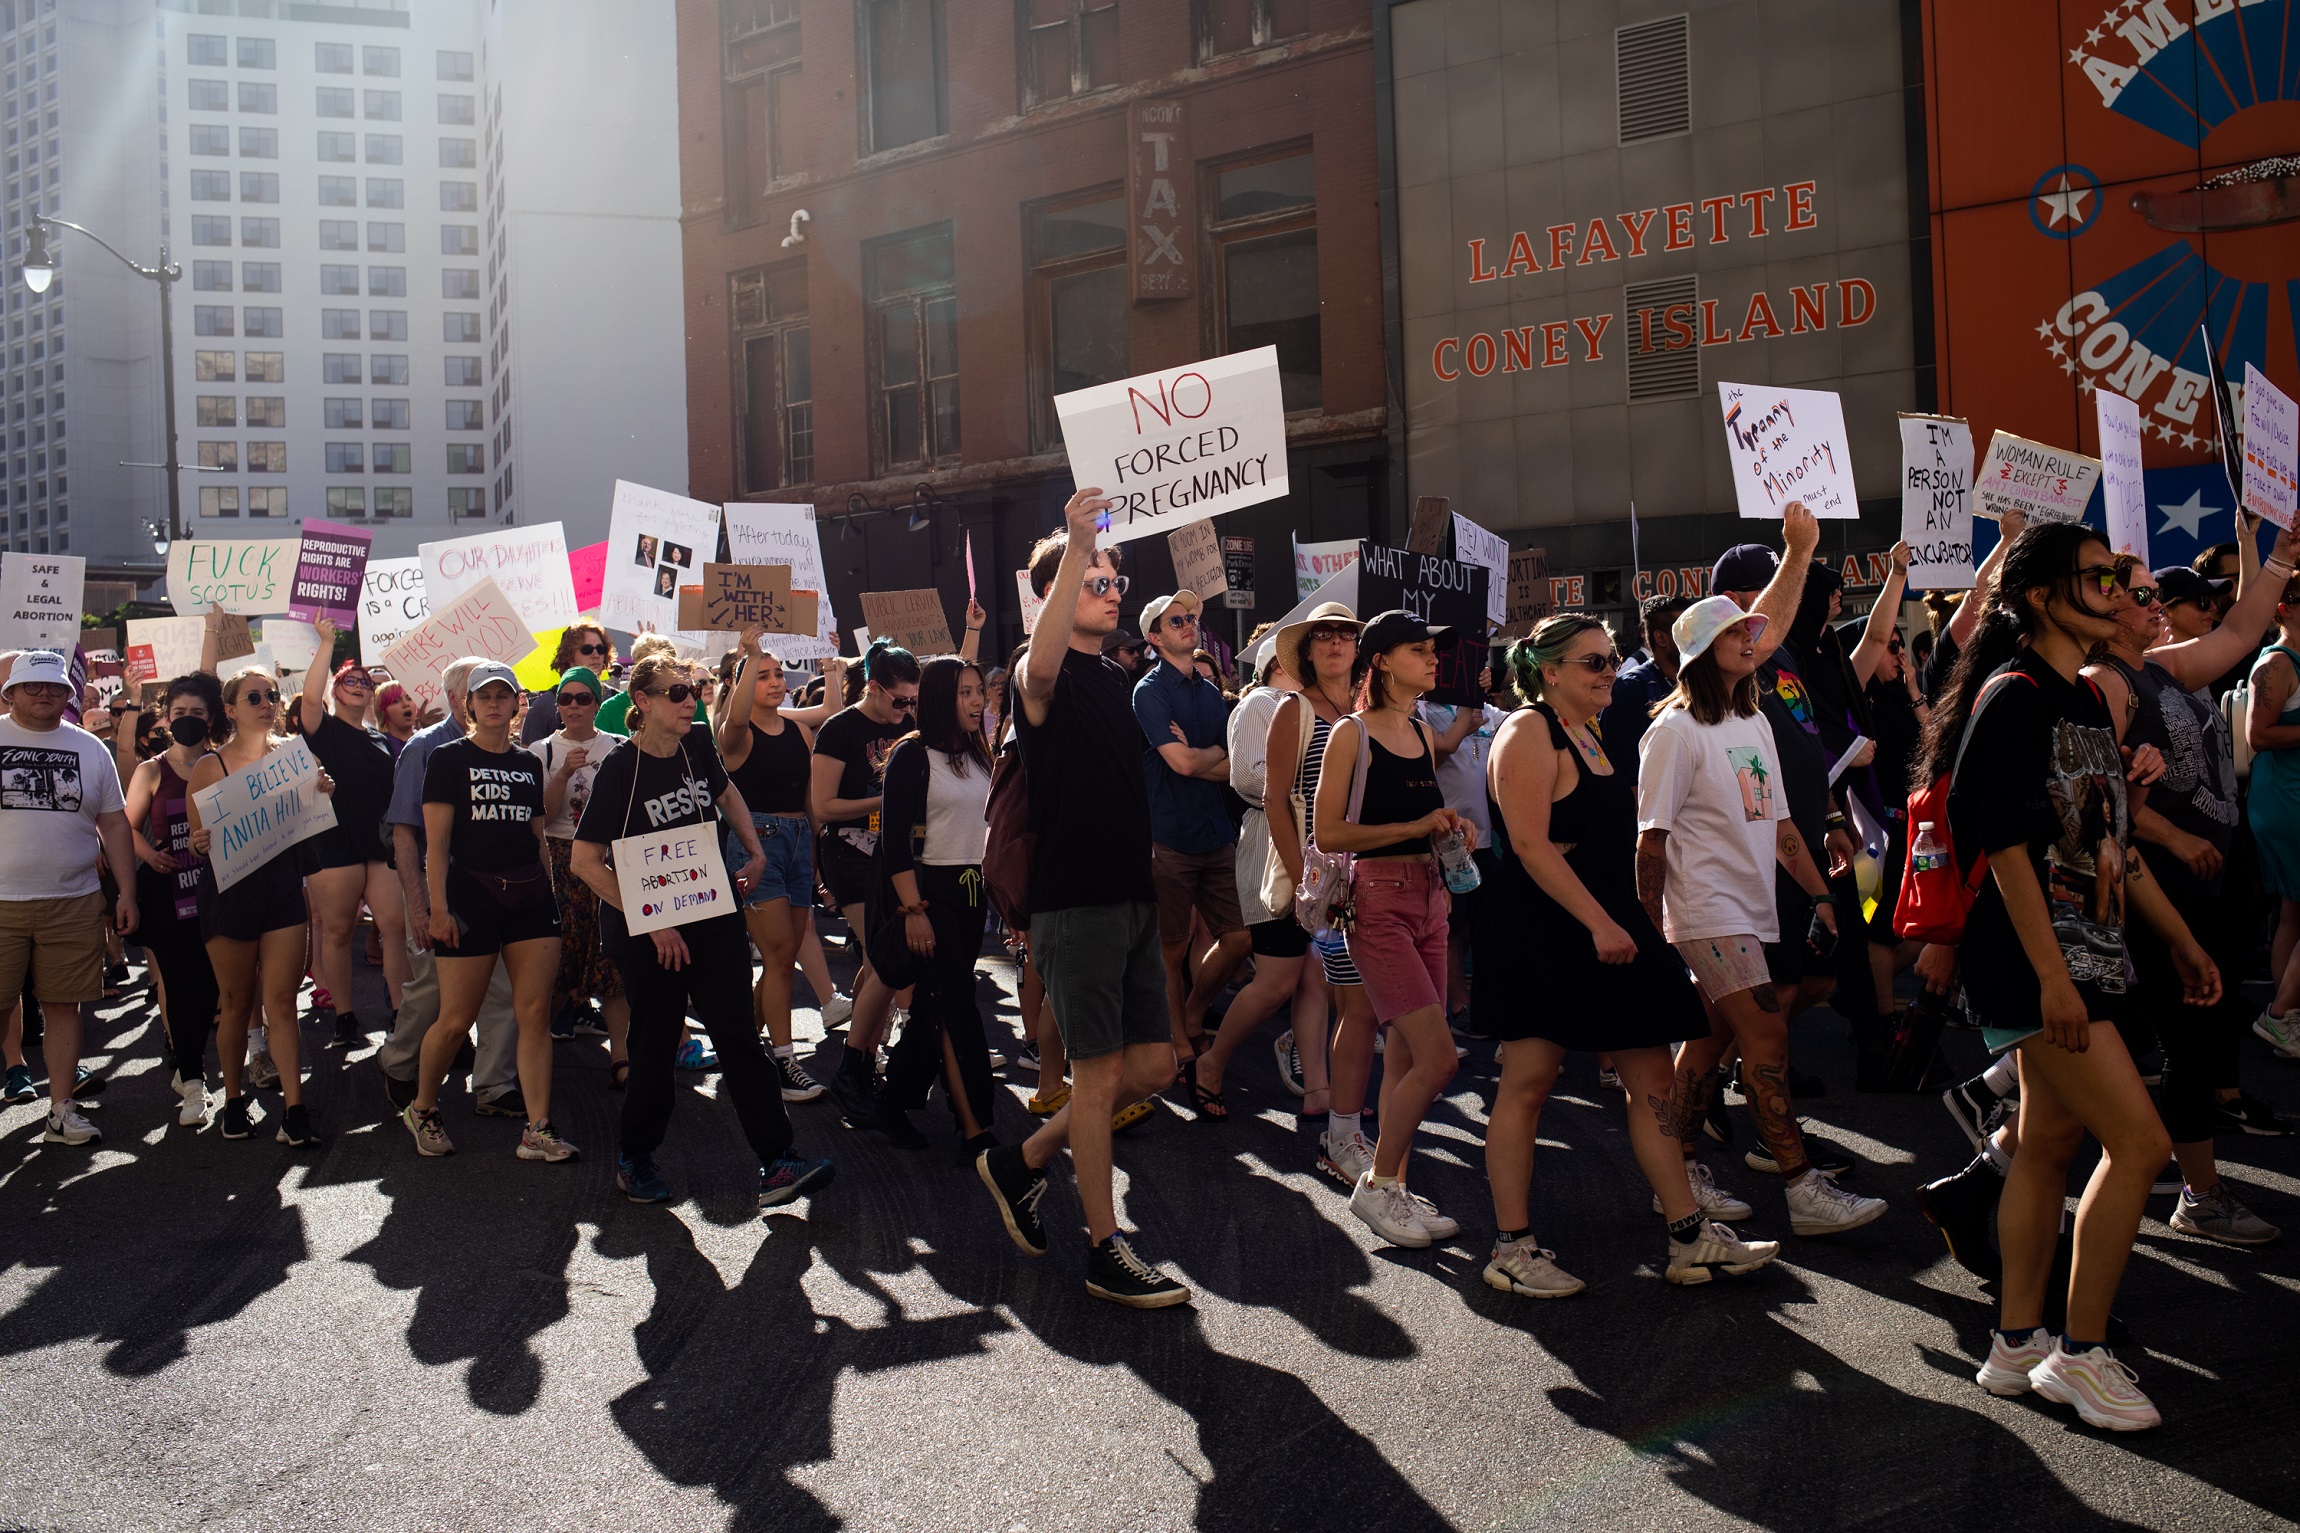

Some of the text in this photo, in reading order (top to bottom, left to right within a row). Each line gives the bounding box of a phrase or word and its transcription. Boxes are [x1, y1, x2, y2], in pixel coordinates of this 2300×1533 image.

[1141, 132, 1183, 265] TAX
[1468, 180, 1818, 283] LAFAYETTE
[1432, 277, 1877, 381] CONEY ISLAND
[1128, 372, 1211, 435] NO
[1728, 388, 1744, 402] the
[1725, 399, 1795, 452] Tyranny
[1926, 424, 1953, 447] I'M
[1114, 426, 1239, 484] FORCED
[1754, 433, 1789, 476] of the
[1936, 449, 1946, 467] A
[1996, 442, 2091, 480] WOMAN RULE
[1763, 440, 1837, 505] Minority
[1908, 466, 1963, 490] PERSON
[2013, 469, 2055, 489] EXCEPT
[1106, 453, 1268, 533] PREGNANCY
[1803, 484, 1828, 504] must
[1824, 493, 1842, 510] end
[1932, 489, 1966, 513] NOT
[1980, 491, 2035, 512] SHE HAS BEEN
[1982, 476, 2083, 507] AMY CONEY BARRETT
[1926, 510, 1952, 530] AN
[1199, 523, 1211, 541] IN
[302, 538, 367, 557] REPRODUCTIVE
[1185, 547, 1206, 568] WOMB
[1207, 542, 1218, 556] FOR
[1225, 539, 1243, 551] ZONE
[1908, 541, 1974, 567] INCUBATOR
[32, 565, 60, 574] SAFE
[188, 545, 280, 582] FUCK
[301, 552, 351, 568] RIGHTS ARE
[439, 547, 489, 580] OUR
[1360, 544, 1478, 594] WHAT ABOUT
[41, 579, 49, 588] &
[300, 565, 363, 586] WORKERS'
[718, 572, 752, 589] I'M
[26, 595, 62, 604] LEGAL
[190, 583, 276, 605] SCOTUS
[297, 582, 347, 601] RIGHTS!
[723, 589, 773, 604] WITH
[1518, 585, 1529, 599] IS
[13, 611, 73, 621] ABORTION
[734, 604, 773, 622] HER
[865, 593, 938, 618] PUBLIC CERVIX
[1403, 588, 1436, 623] MY
[1506, 603, 1547, 623] EALTHCARE
[218, 632, 253, 656] IGHTS
[385, 596, 491, 673] THERE WILL
[928, 627, 951, 644] LAWS
[415, 681, 442, 703] BE
[2, 749, 77, 766] SONIC YOUTH
[207, 750, 309, 825] I BELIEVE
[469, 767, 536, 786] DETROIT
[470, 783, 511, 801] KIDS
[644, 774, 712, 828] RESIS
[471, 804, 533, 822] MATTER
[223, 807, 271, 861] ANITA
[644, 839, 698, 866] FREE
[641, 863, 708, 891] ABORTION
[642, 888, 717, 917] ON DEMAND
